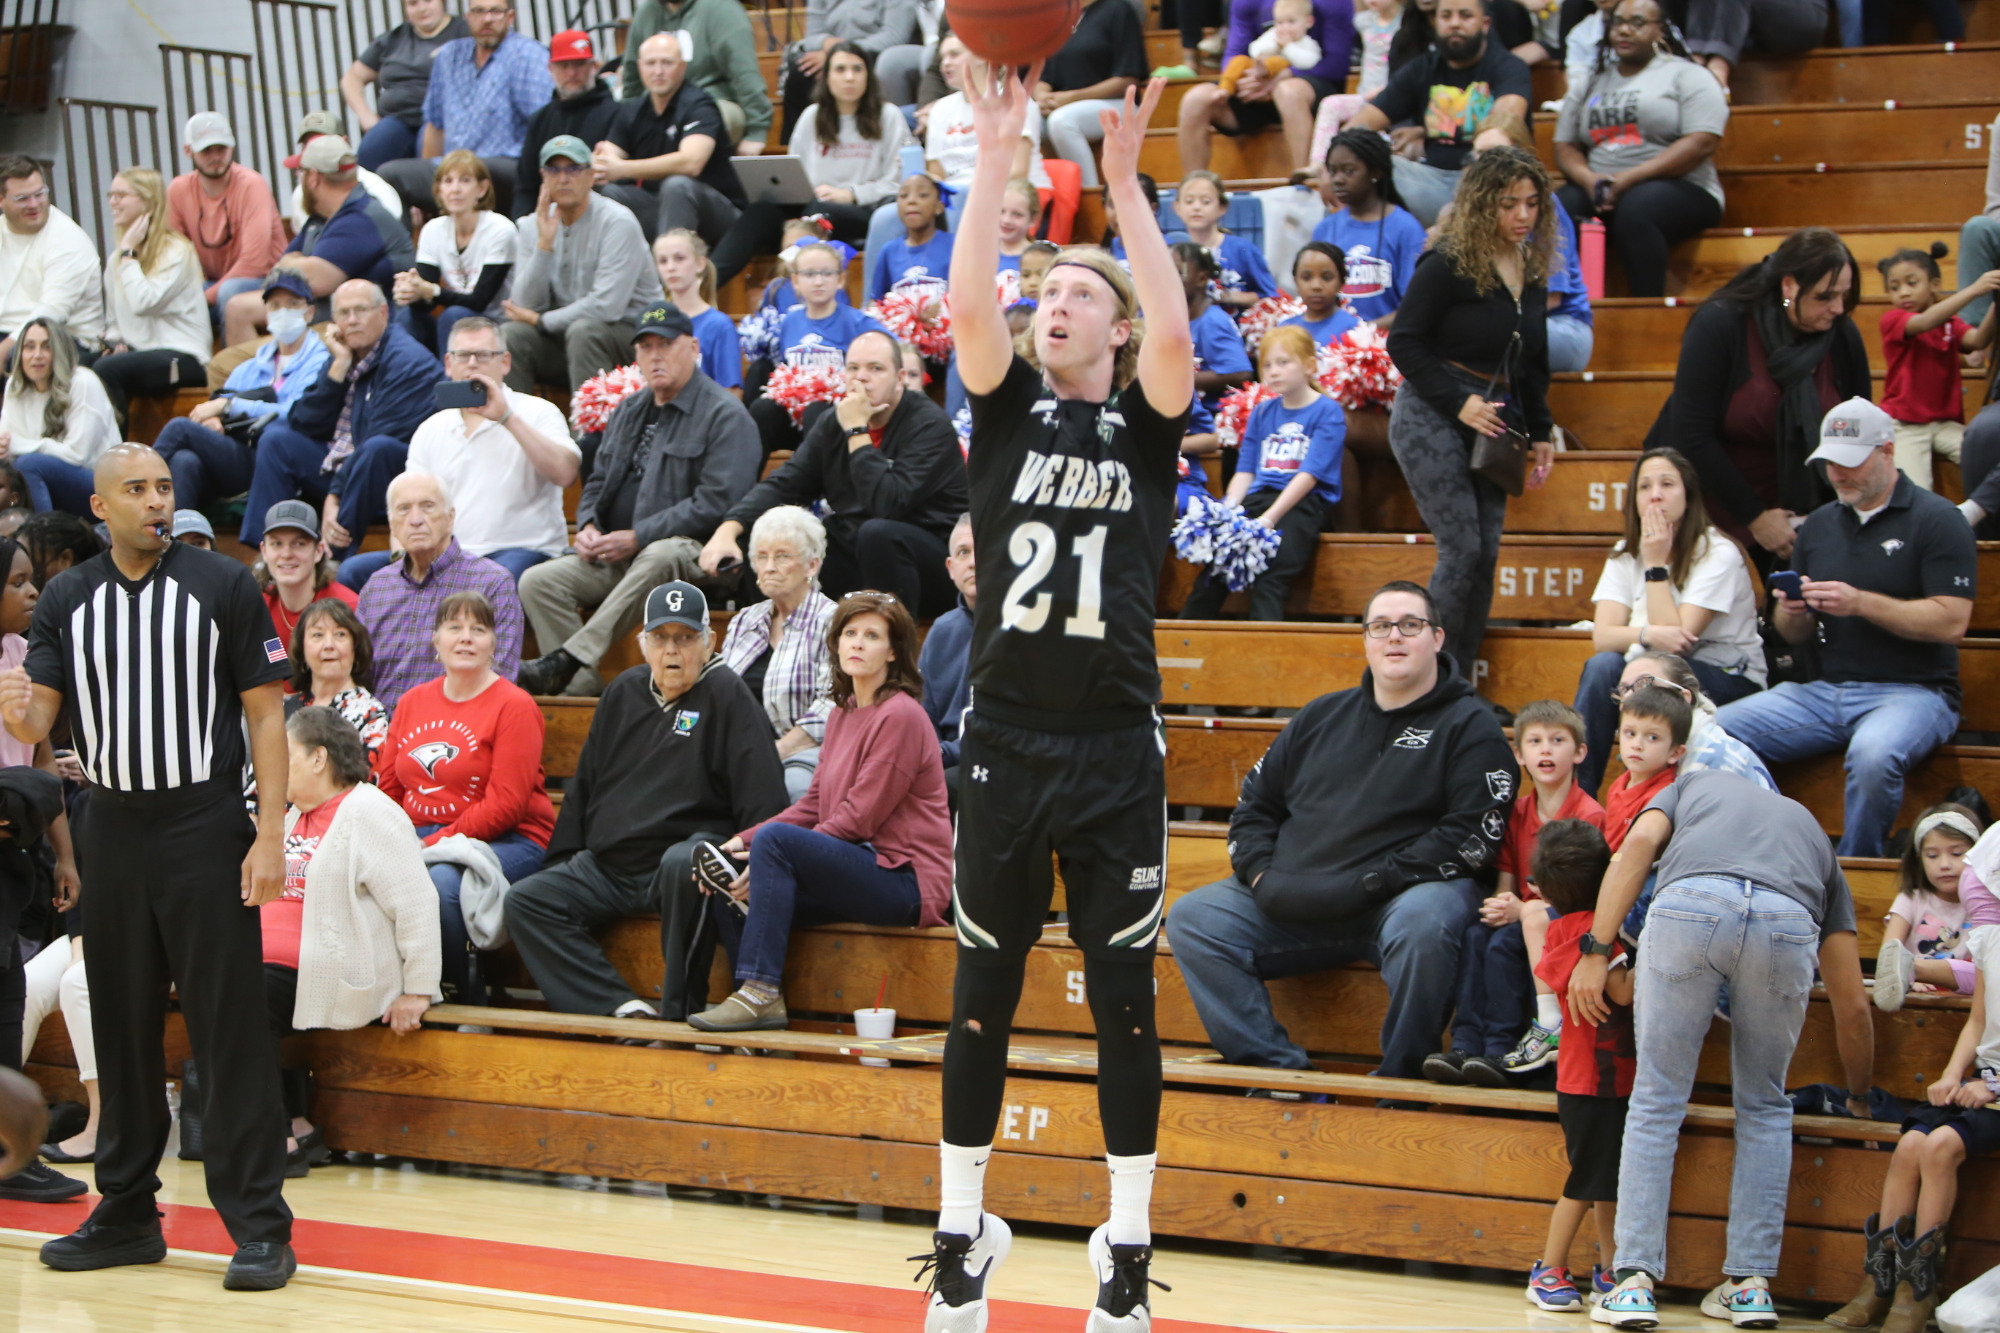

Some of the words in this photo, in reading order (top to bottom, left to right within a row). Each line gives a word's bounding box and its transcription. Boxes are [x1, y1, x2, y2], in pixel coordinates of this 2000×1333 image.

[1588, 105, 1638, 130] ARE
[1011, 449, 1133, 512] WEBBER
[1588, 482, 1627, 511] ST
[1001, 520, 1108, 640] 21
[1500, 566, 1583, 596] STEP
[1002, 1104, 1049, 1141] EP
